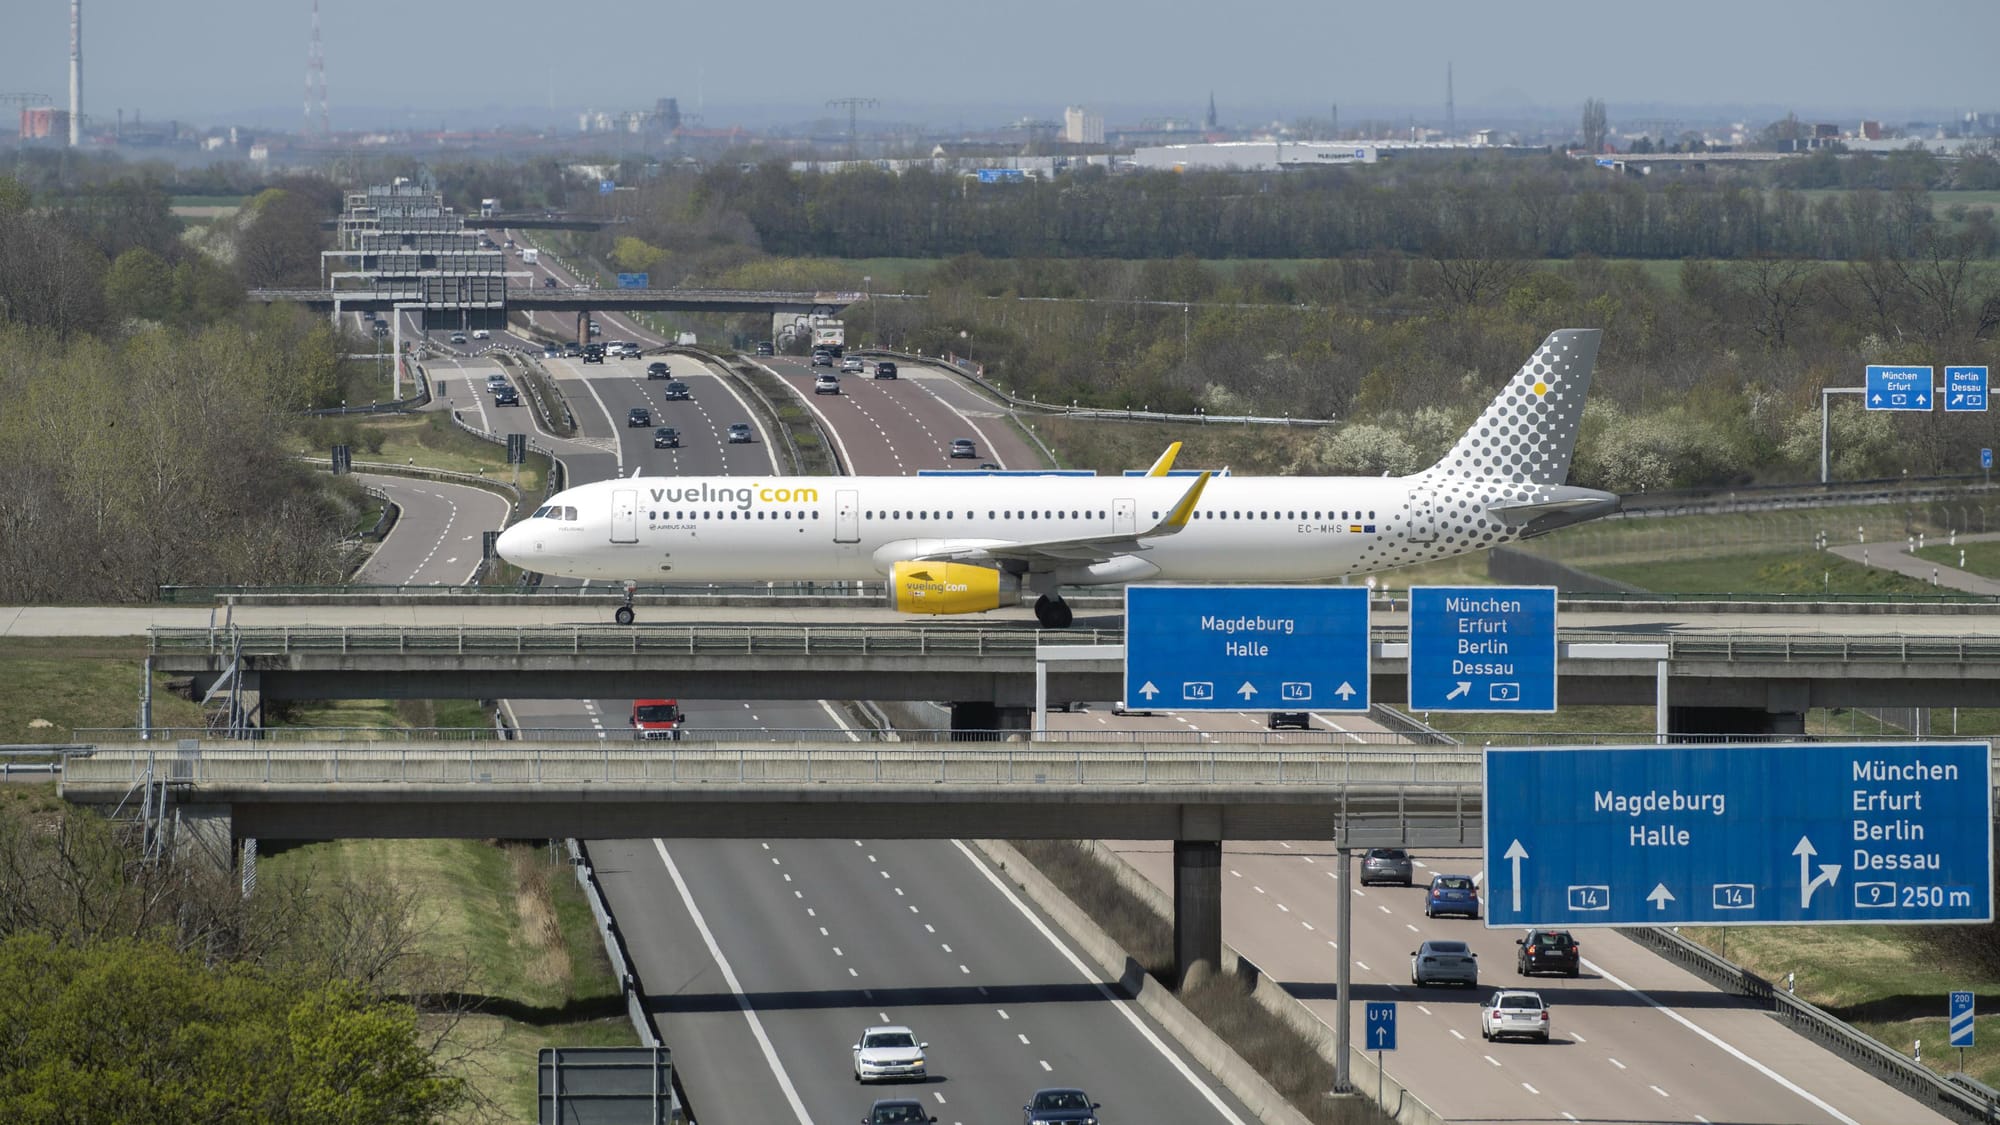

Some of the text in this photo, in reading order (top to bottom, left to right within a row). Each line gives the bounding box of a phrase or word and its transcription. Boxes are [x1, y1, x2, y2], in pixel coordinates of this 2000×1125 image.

[1882, 371, 1917, 380] München
[1954, 372, 1979, 381] Berlin
[1887, 382, 1911, 391] Erfurt
[1951, 383, 1981, 392] Dessau
[1297, 524, 1342, 534] EC-MHS
[1446, 597, 1520, 613] München
[1201, 615, 1294, 634] Magdeburg
[1458, 618, 1508, 633] Erfurt
[1226, 641, 1269, 656] Halle
[1458, 639, 1508, 654] Berlin
[1452, 659, 1514, 675] Dessau
[1192, 685, 1205, 697] 14
[1290, 685, 1303, 697] 14
[1501, 687, 1508, 698] 9
[1853, 760, 1959, 782] München
[1594, 790, 1726, 817] Magdeburg
[1853, 789, 1922, 811] Erfurt
[1630, 825, 1690, 846] Halle
[1853, 819, 1924, 841] Berlin
[1854, 849, 1940, 871] Dessau
[1580, 890, 1597, 906] 14
[1725, 889, 1743, 905] 14
[1870, 886, 1971, 907] 9 250 m
[1954, 994, 1970, 1003] 200
[1370, 1009, 1393, 1021] U 91
